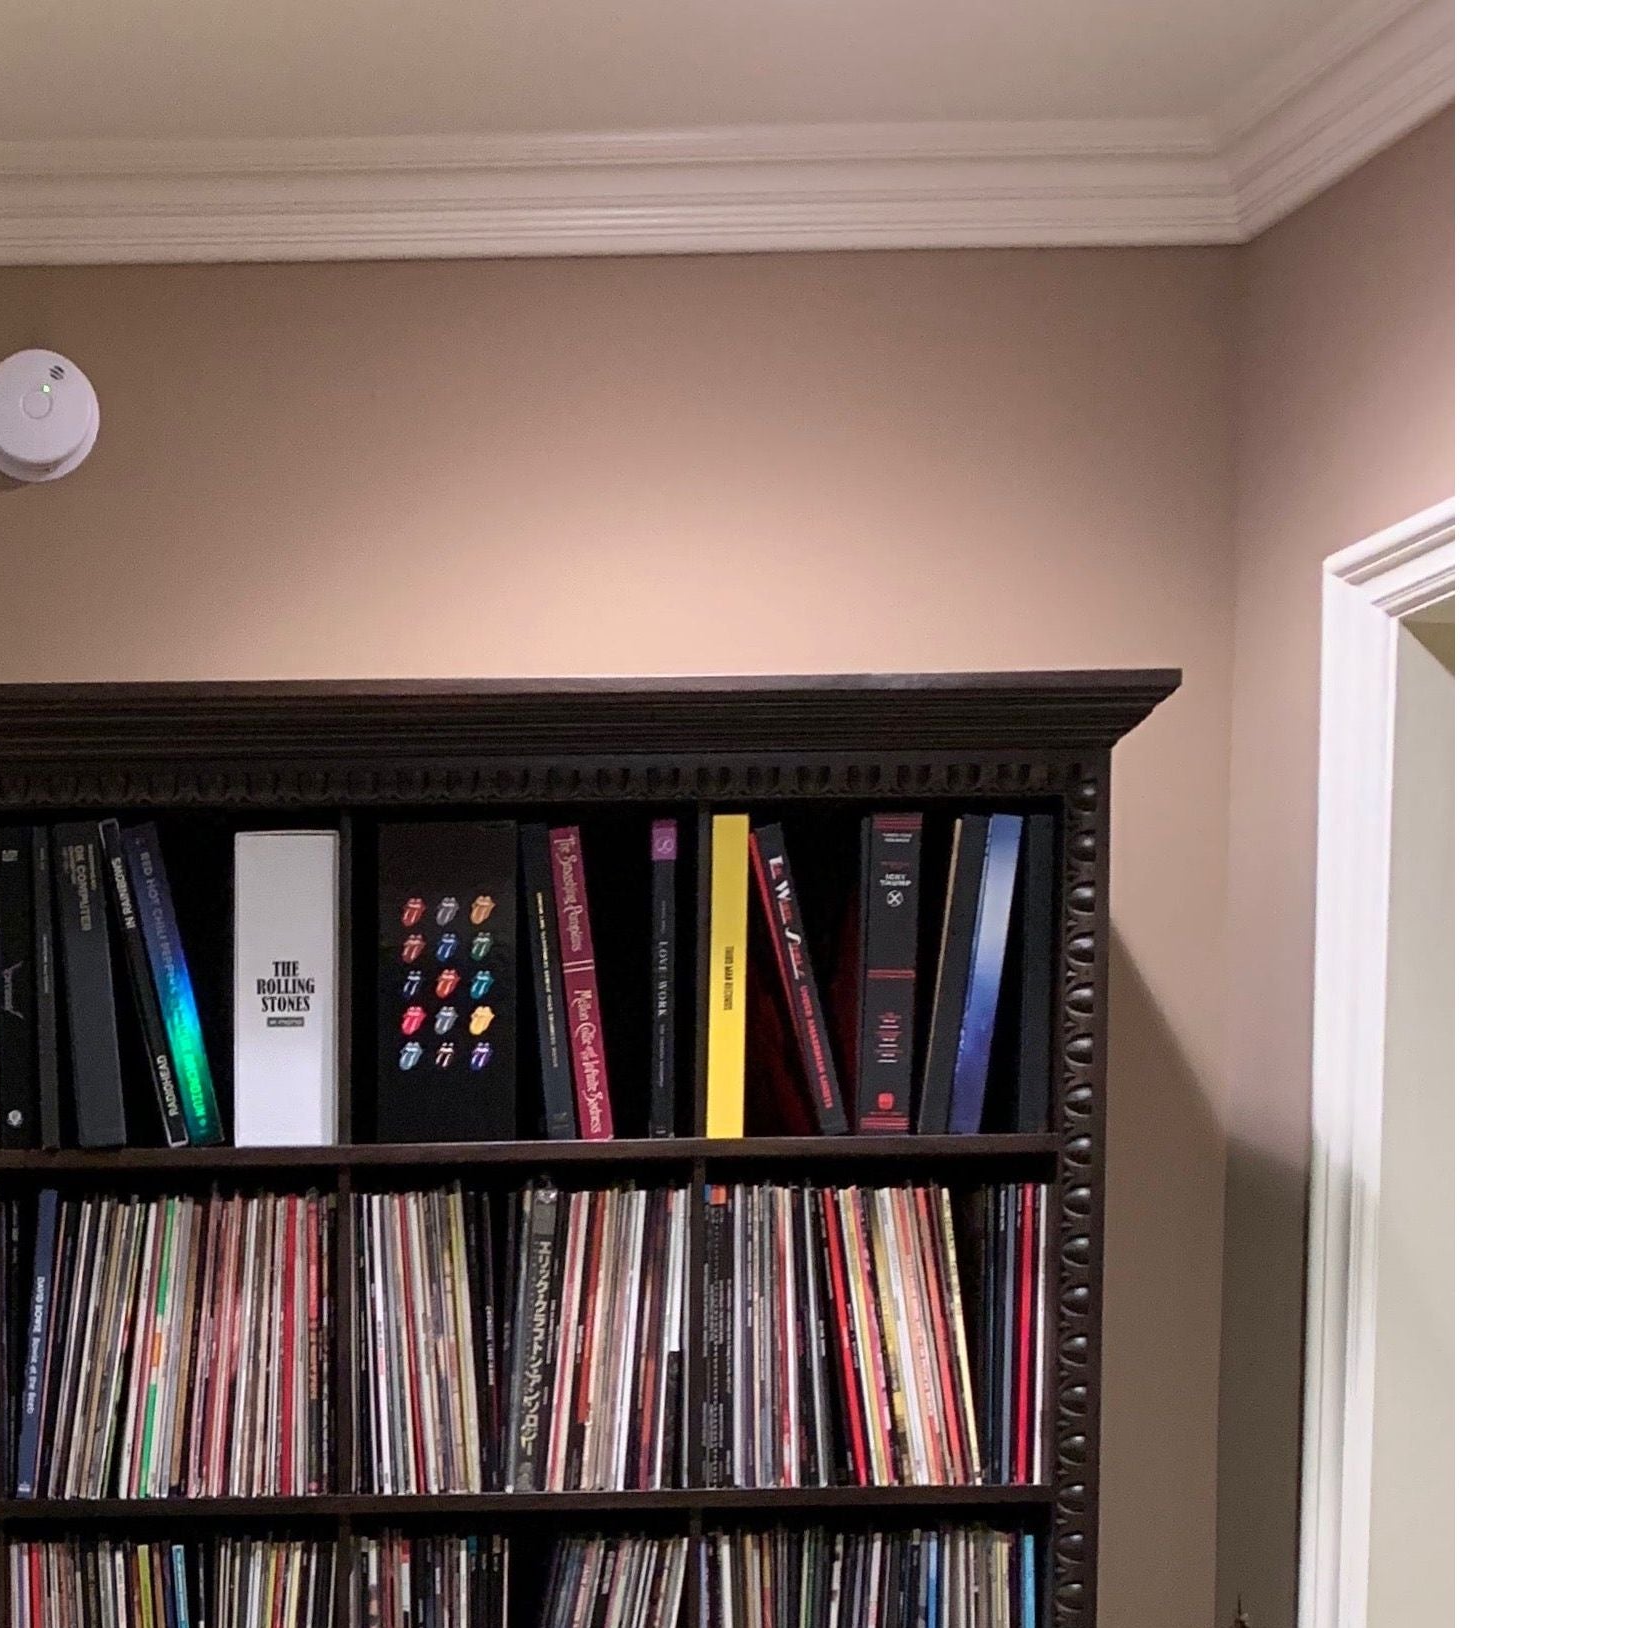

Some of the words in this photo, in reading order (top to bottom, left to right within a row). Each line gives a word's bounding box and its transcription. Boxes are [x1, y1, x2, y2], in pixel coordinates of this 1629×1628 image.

[74, 844, 86, 862] OK
[139, 852, 154, 876] RED
[76, 864, 93, 932] COMPUTER
[110, 856, 133, 916] RAINBOWS
[146, 878, 161, 904] HOT
[124, 916, 137, 930] IN
[152, 908, 168, 940] CHILI
[272, 961, 299, 978] THE
[658, 941, 669, 974] LOVE
[256, 978, 316, 996] ROLLING
[658, 980, 669, 1017] WORK
[261, 995, 311, 1013] STONES
[156, 1054, 180, 1118] RADIOHEAD
[34, 1276, 47, 1304] DAVID
[32, 1304, 44, 1333] BOWIE
[29, 1337, 41, 1364] Bowie
[27, 1375, 38, 1390] the
